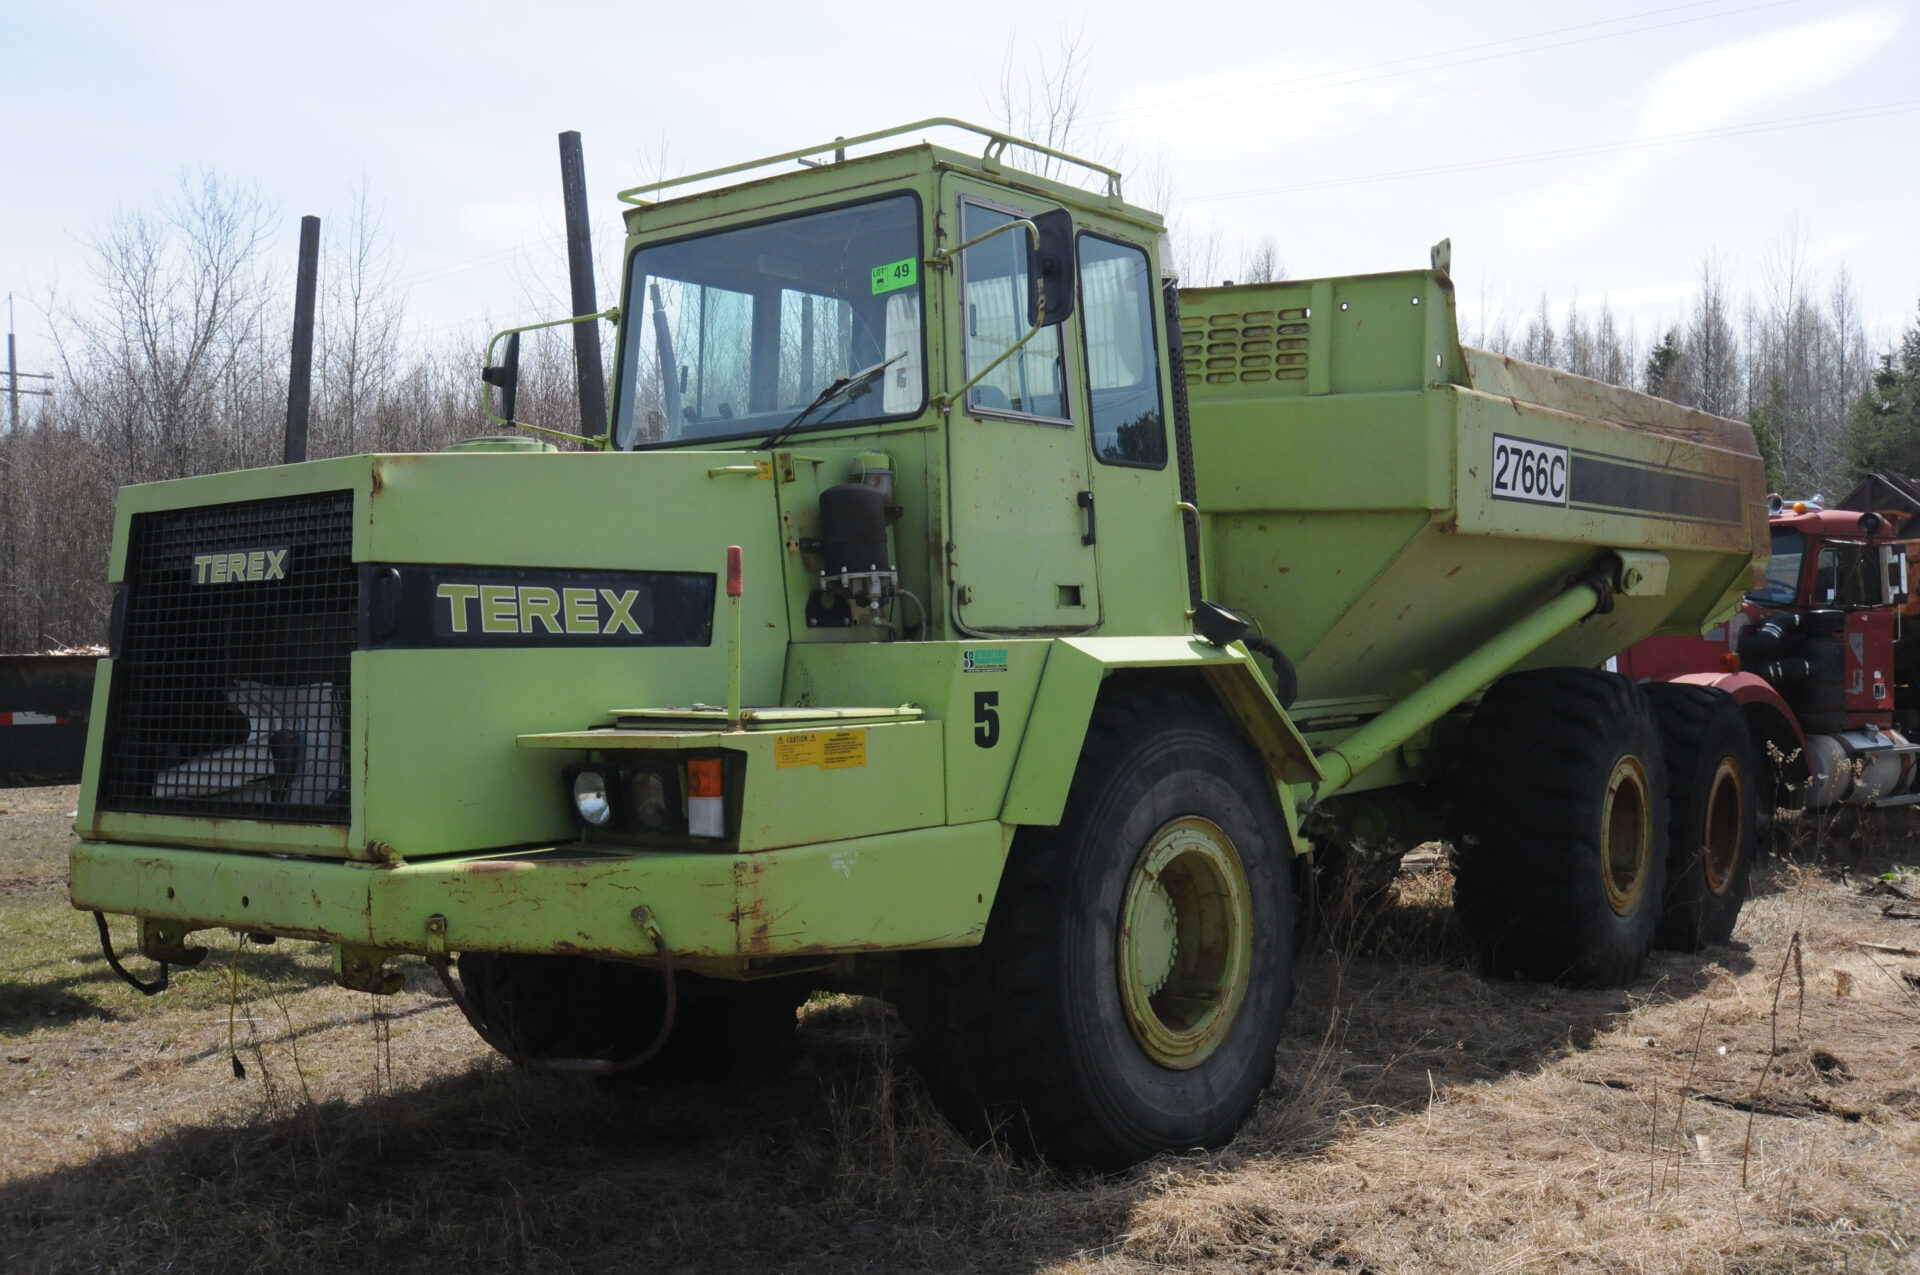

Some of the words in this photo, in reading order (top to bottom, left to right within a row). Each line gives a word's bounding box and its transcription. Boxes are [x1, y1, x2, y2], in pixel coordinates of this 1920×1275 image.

[894, 263, 910, 279] 49
[1494, 444, 1565, 498] 2766C
[194, 549, 288, 584] TEREX
[436, 583, 643, 634] TEREX
[786, 735, 808, 744] CAUTION
[974, 691, 1000, 749] 5
